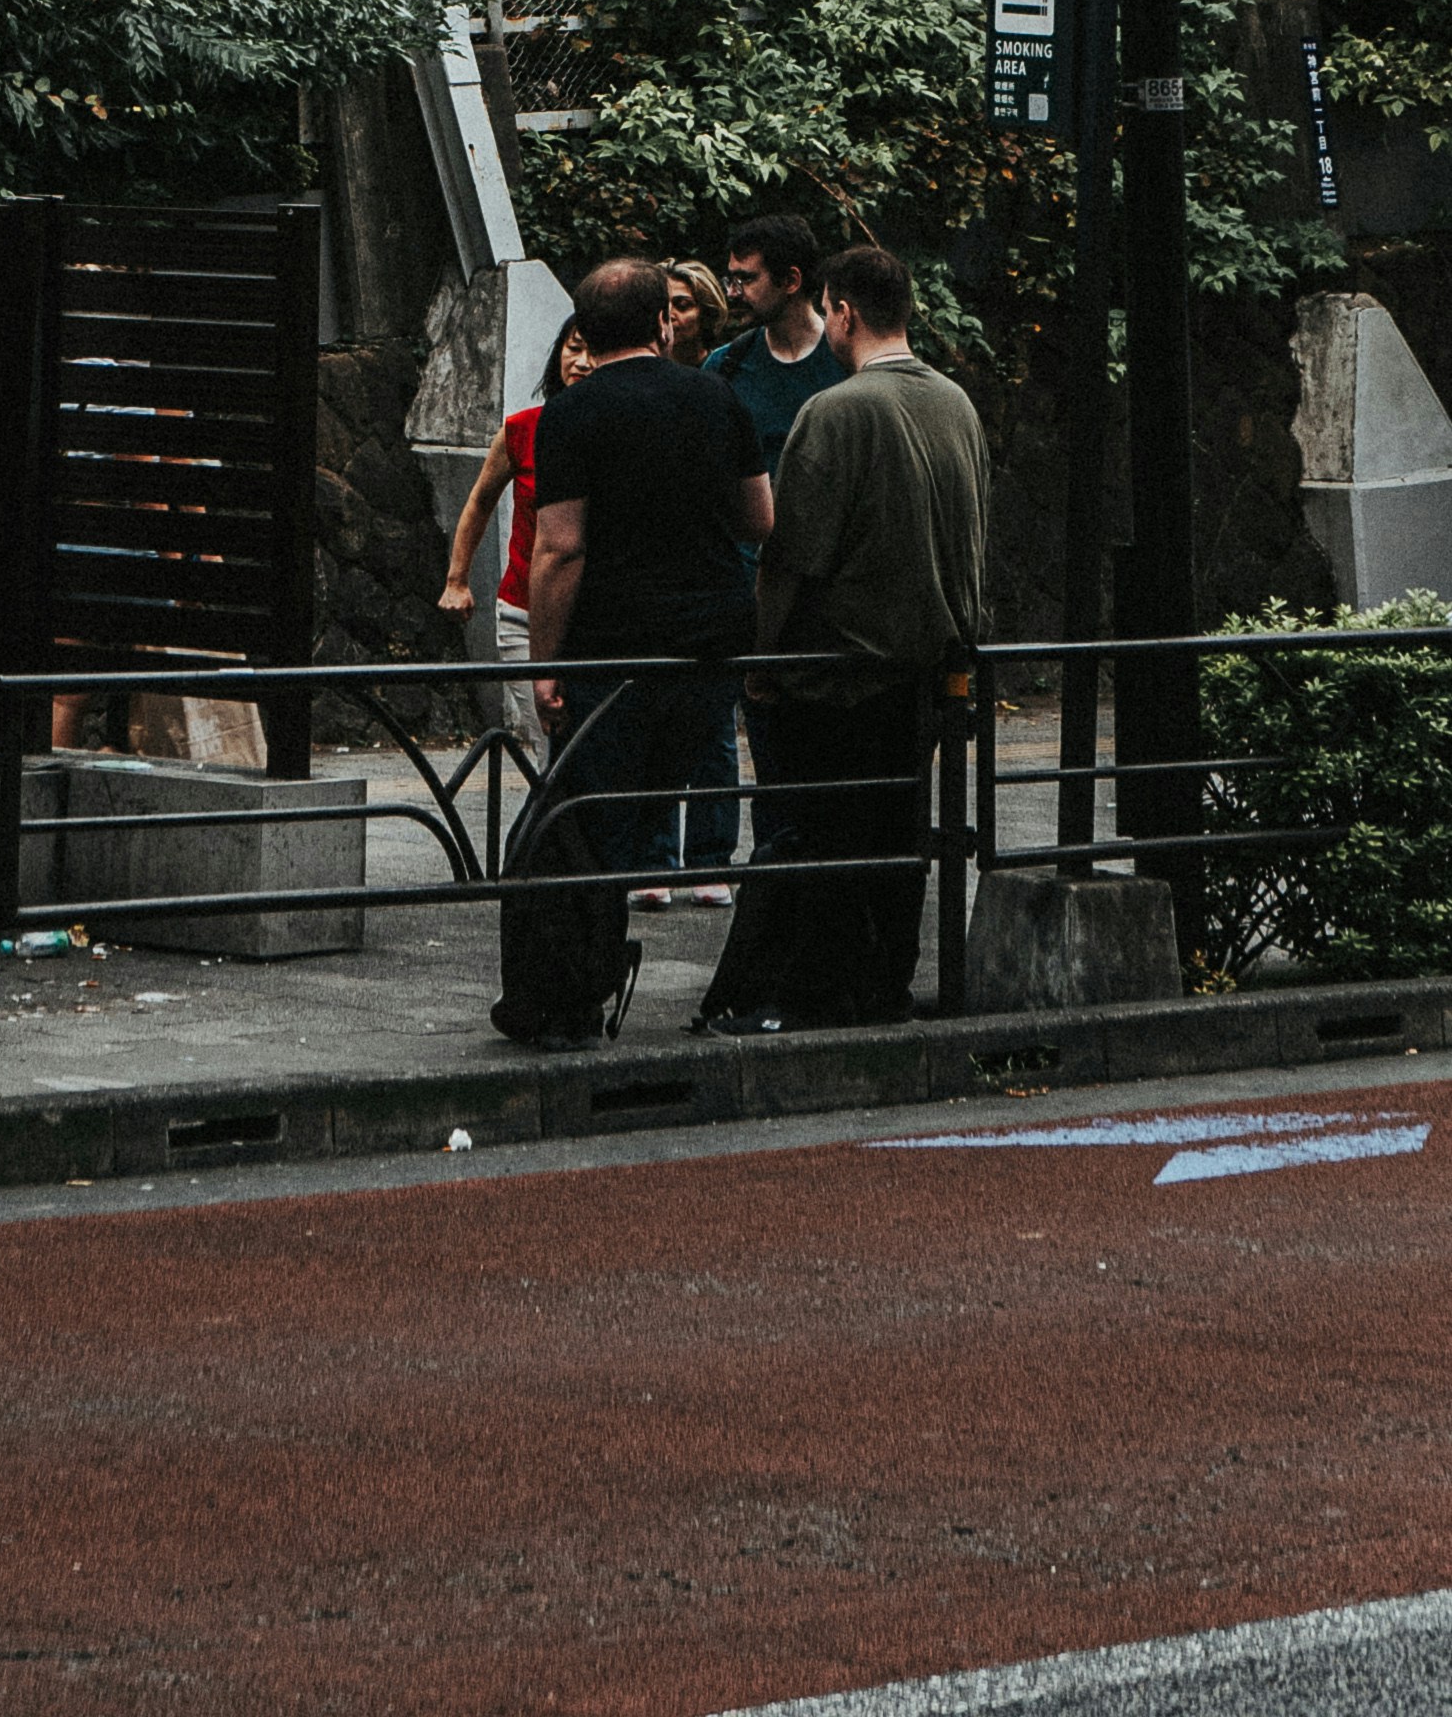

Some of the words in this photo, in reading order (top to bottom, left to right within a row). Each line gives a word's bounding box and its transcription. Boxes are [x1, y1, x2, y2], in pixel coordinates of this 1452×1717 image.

[995, 40, 1053, 59] SMOKING
[994, 59, 1027, 76] AREA
[1318, 156, 1333, 175] 18
